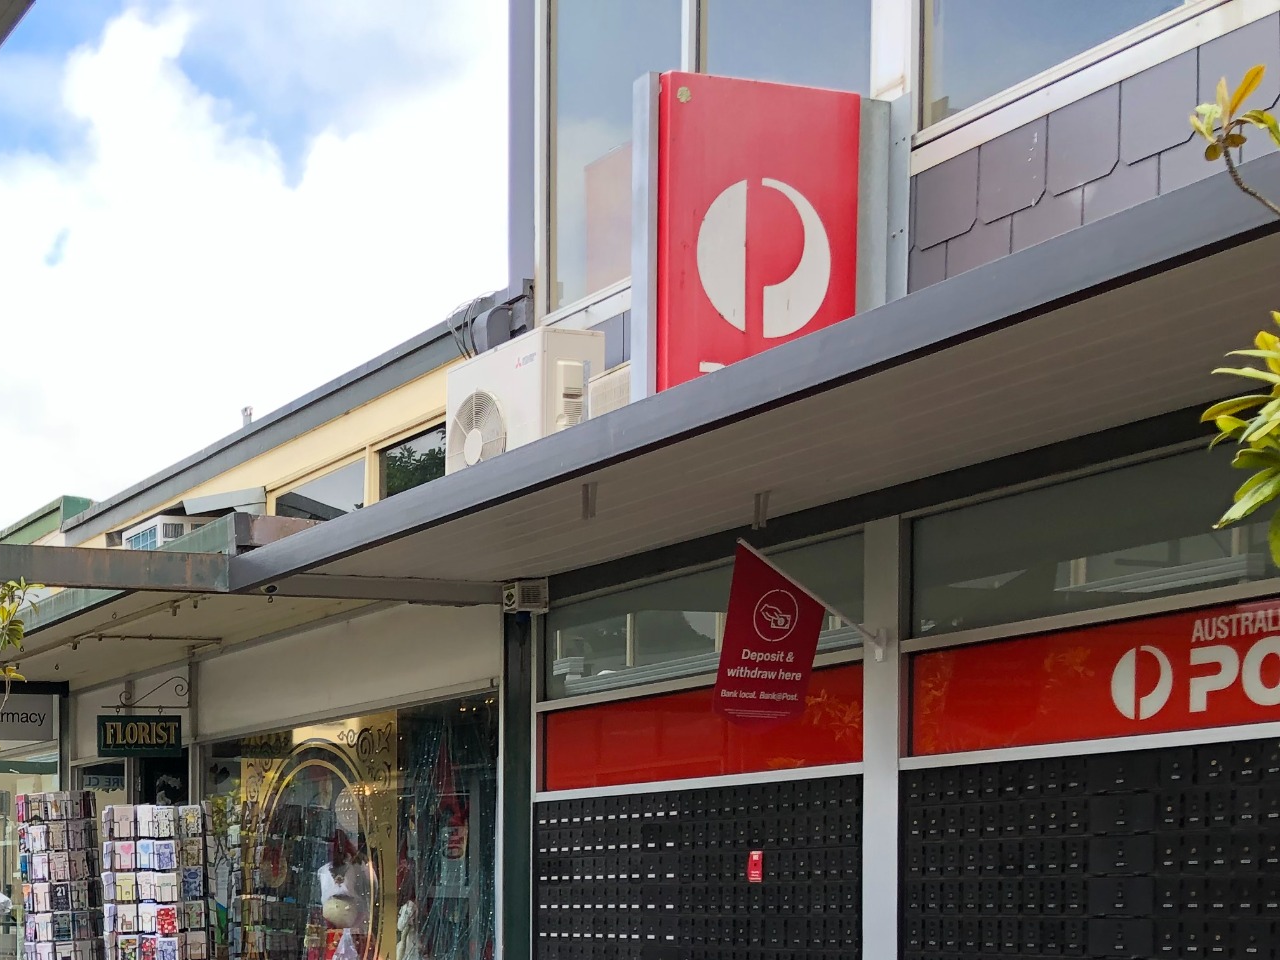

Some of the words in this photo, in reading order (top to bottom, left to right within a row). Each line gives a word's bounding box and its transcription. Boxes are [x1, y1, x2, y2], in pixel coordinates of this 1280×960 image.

[741, 648, 784, 663] Deposit
[786, 651, 795, 663] &
[727, 666, 776, 680] withdraw
[778, 668, 802, 681] here
[721, 689, 738, 698] Bank
[739, 689, 756, 699] local.
[759, 691, 799, 702] Bank@Post.
[105, 722, 179, 745] FLORIST
